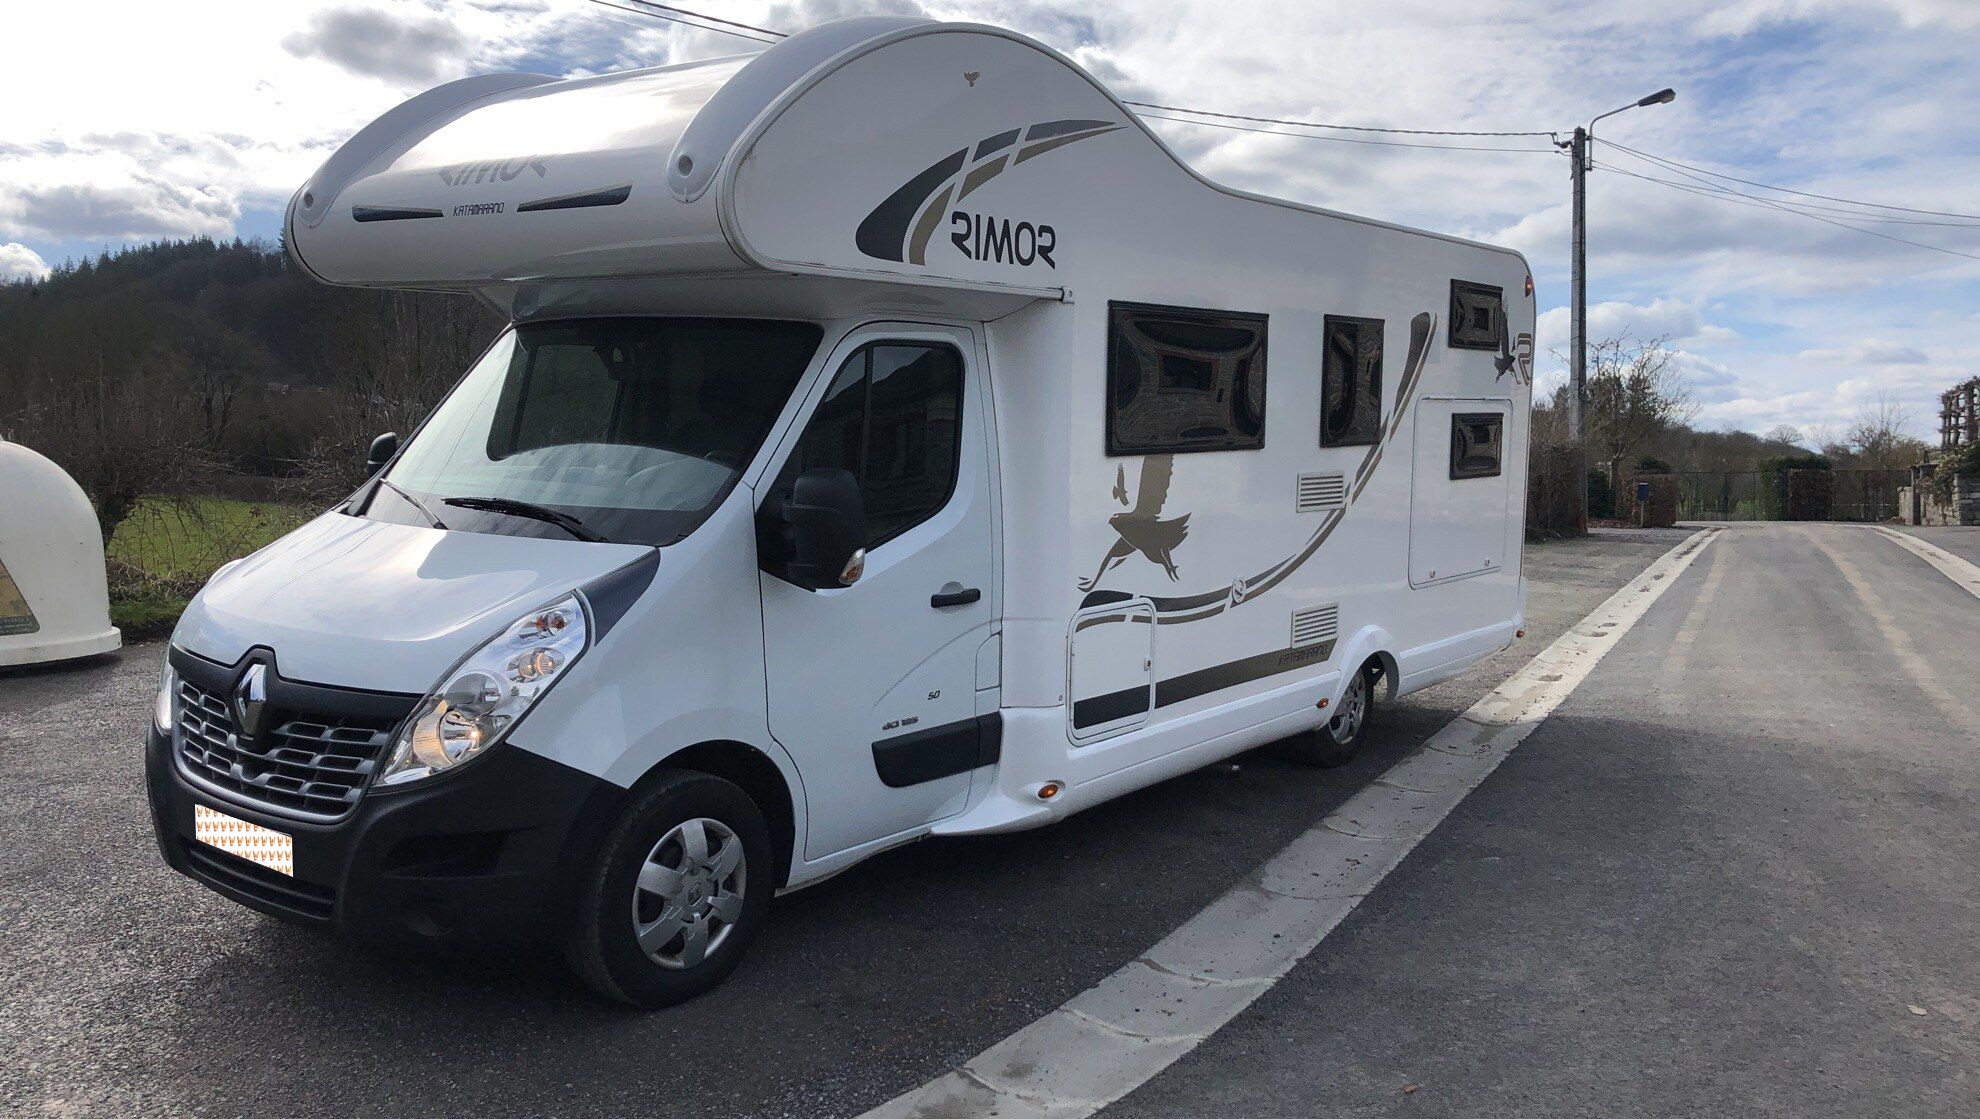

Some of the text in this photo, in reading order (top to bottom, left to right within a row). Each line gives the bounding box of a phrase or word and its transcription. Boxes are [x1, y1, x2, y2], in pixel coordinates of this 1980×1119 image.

[452, 202, 505, 217] KATAMARANO
[950, 210, 1056, 270] RIMOR
[927, 690, 941, 701] 50
